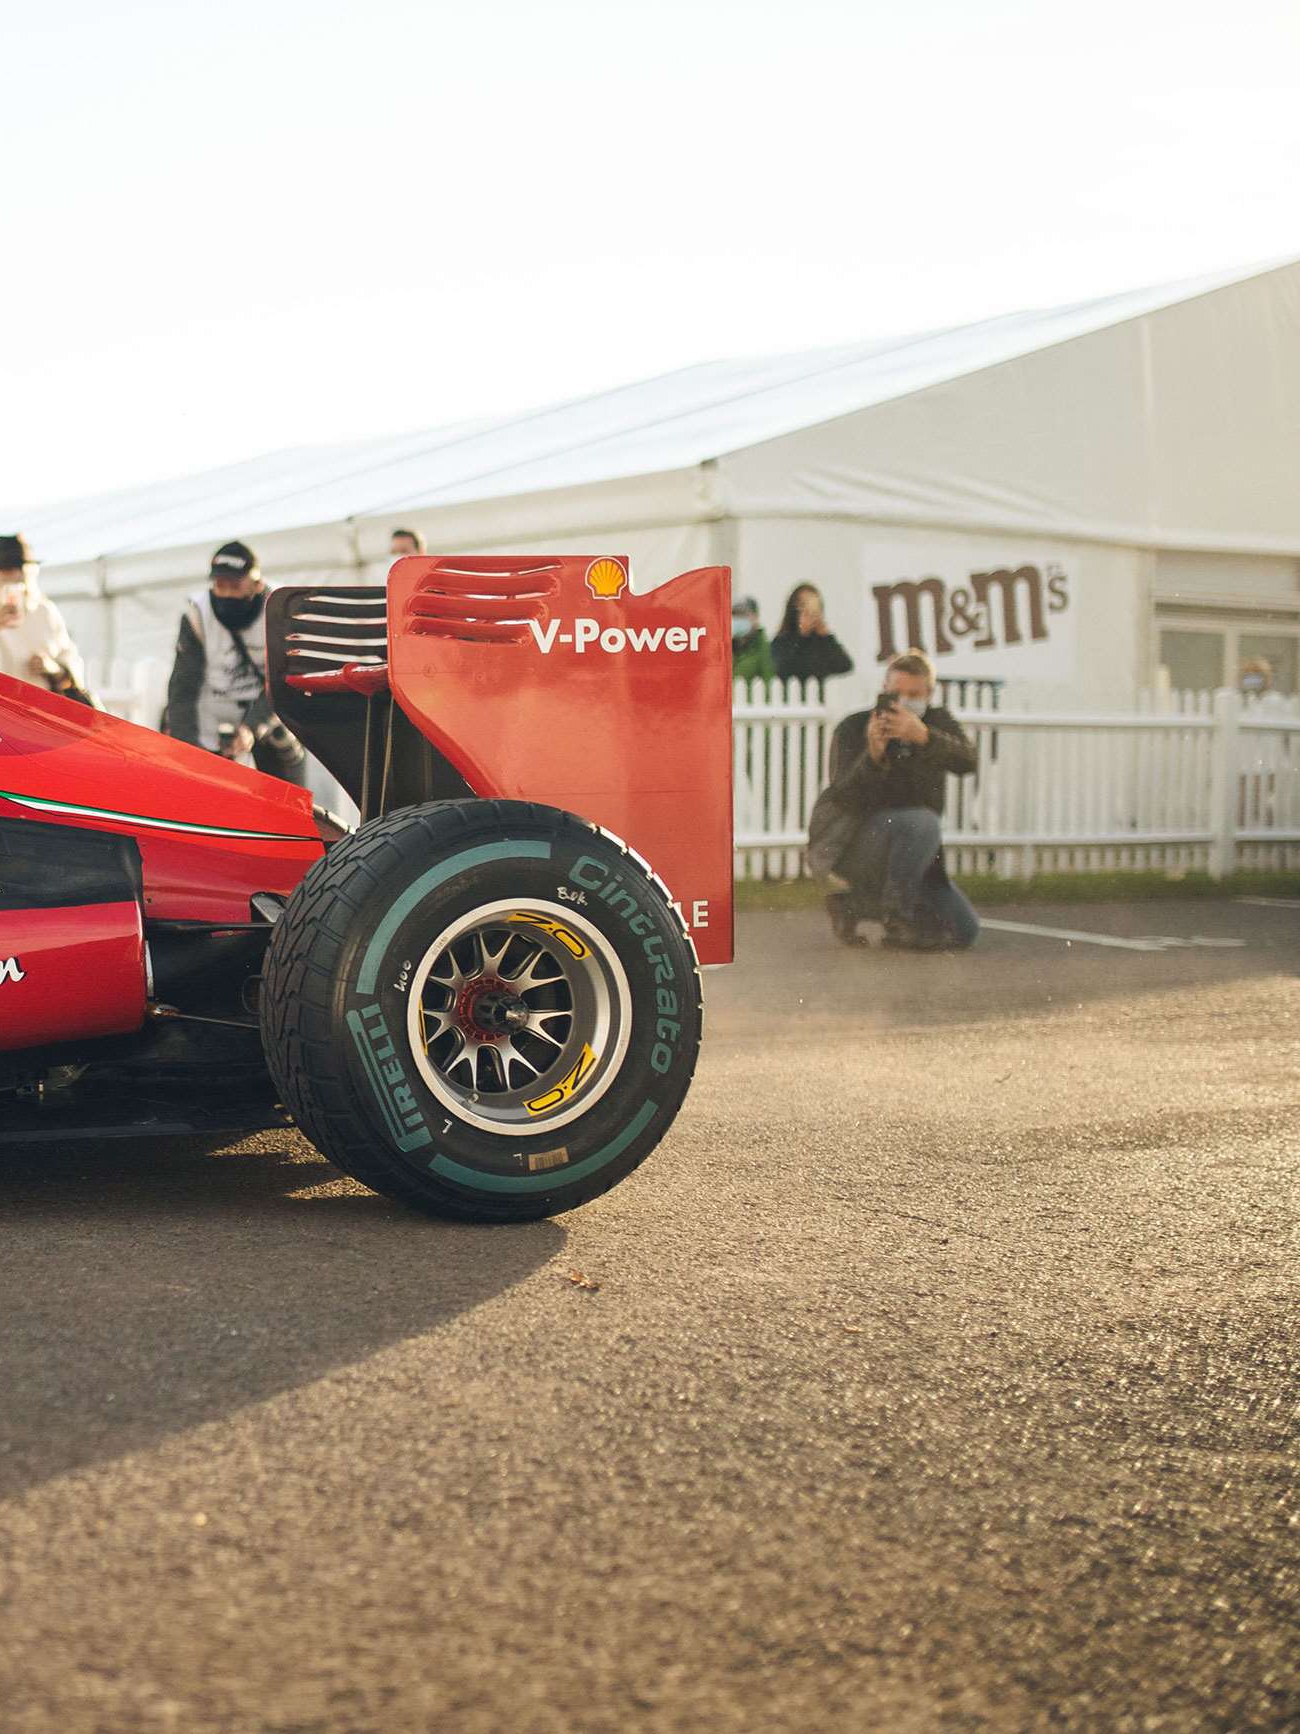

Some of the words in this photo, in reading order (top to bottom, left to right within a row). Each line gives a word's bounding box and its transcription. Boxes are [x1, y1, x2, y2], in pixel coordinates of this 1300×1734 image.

[529, 618, 706, 653] V-Power
[568, 855, 681, 1075] Cinturato
[346, 1003, 435, 1153] PIRELLI
